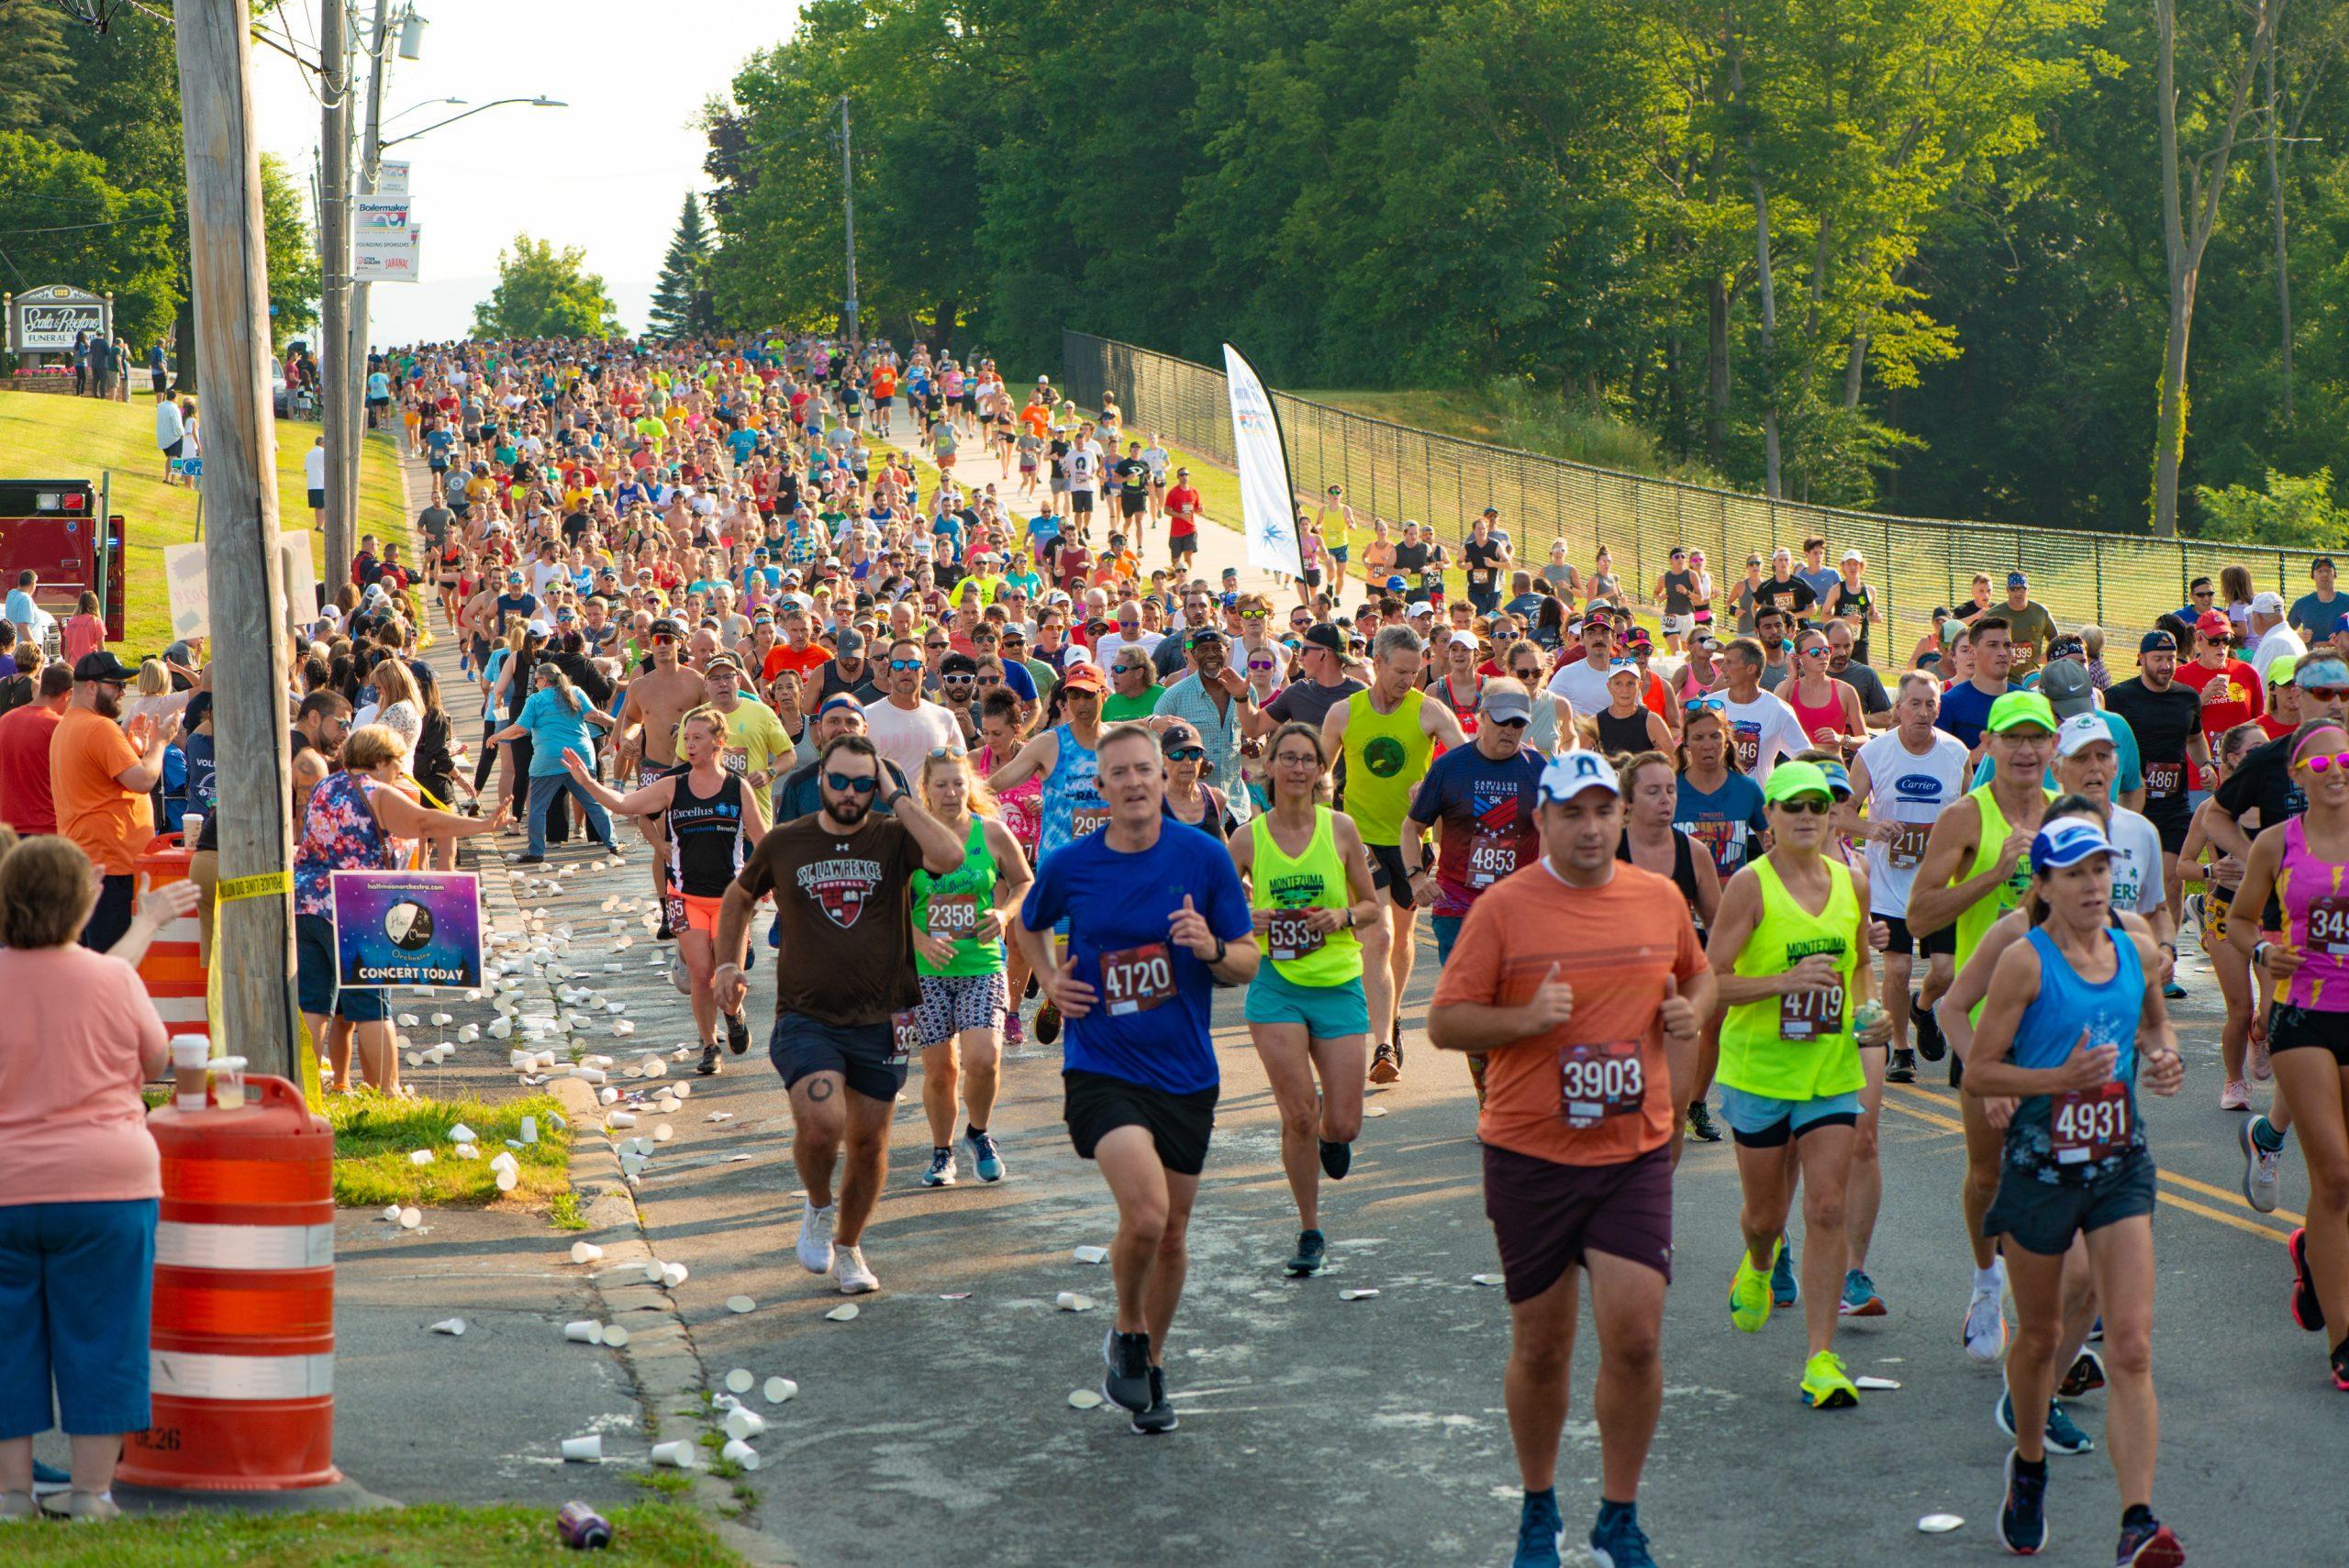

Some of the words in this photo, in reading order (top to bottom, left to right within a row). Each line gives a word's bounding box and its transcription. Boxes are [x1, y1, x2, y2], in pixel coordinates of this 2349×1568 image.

[384, 257, 408, 269] SARANAC
[26, 308, 53, 332] Scala
[28, 334, 66, 342] FUNERAL
[1475, 780, 1518, 788] CAMILLUS
[1901, 779, 1937, 790] Carrier
[2147, 771, 2178, 788] 4861
[673, 806, 714, 819] Excellus
[683, 825, 716, 834] Everybody
[1472, 847, 1517, 872] 4853
[814, 859, 883, 882] LAWRENCE
[245, 878, 260, 893] LINE
[261, 875, 283, 892] POLICE
[367, 883, 444, 891] halfmoonorchestra.com
[817, 881, 863, 889] FOOTBALL
[1269, 874, 1324, 891] MONTEZUMA
[390, 916, 408, 929] Half
[928, 904, 974, 928] 2358
[408, 929, 430, 940] Moon
[1787, 937, 1846, 956] MONTEZUMA
[391, 949, 431, 962] Orchestra
[358, 967, 419, 979] CONCERT
[422, 968, 464, 981] TODAY
[1106, 957, 1170, 998] 4720
[1564, 1057, 1642, 1098] 3903
[2056, 1098, 2125, 1140] 4931
